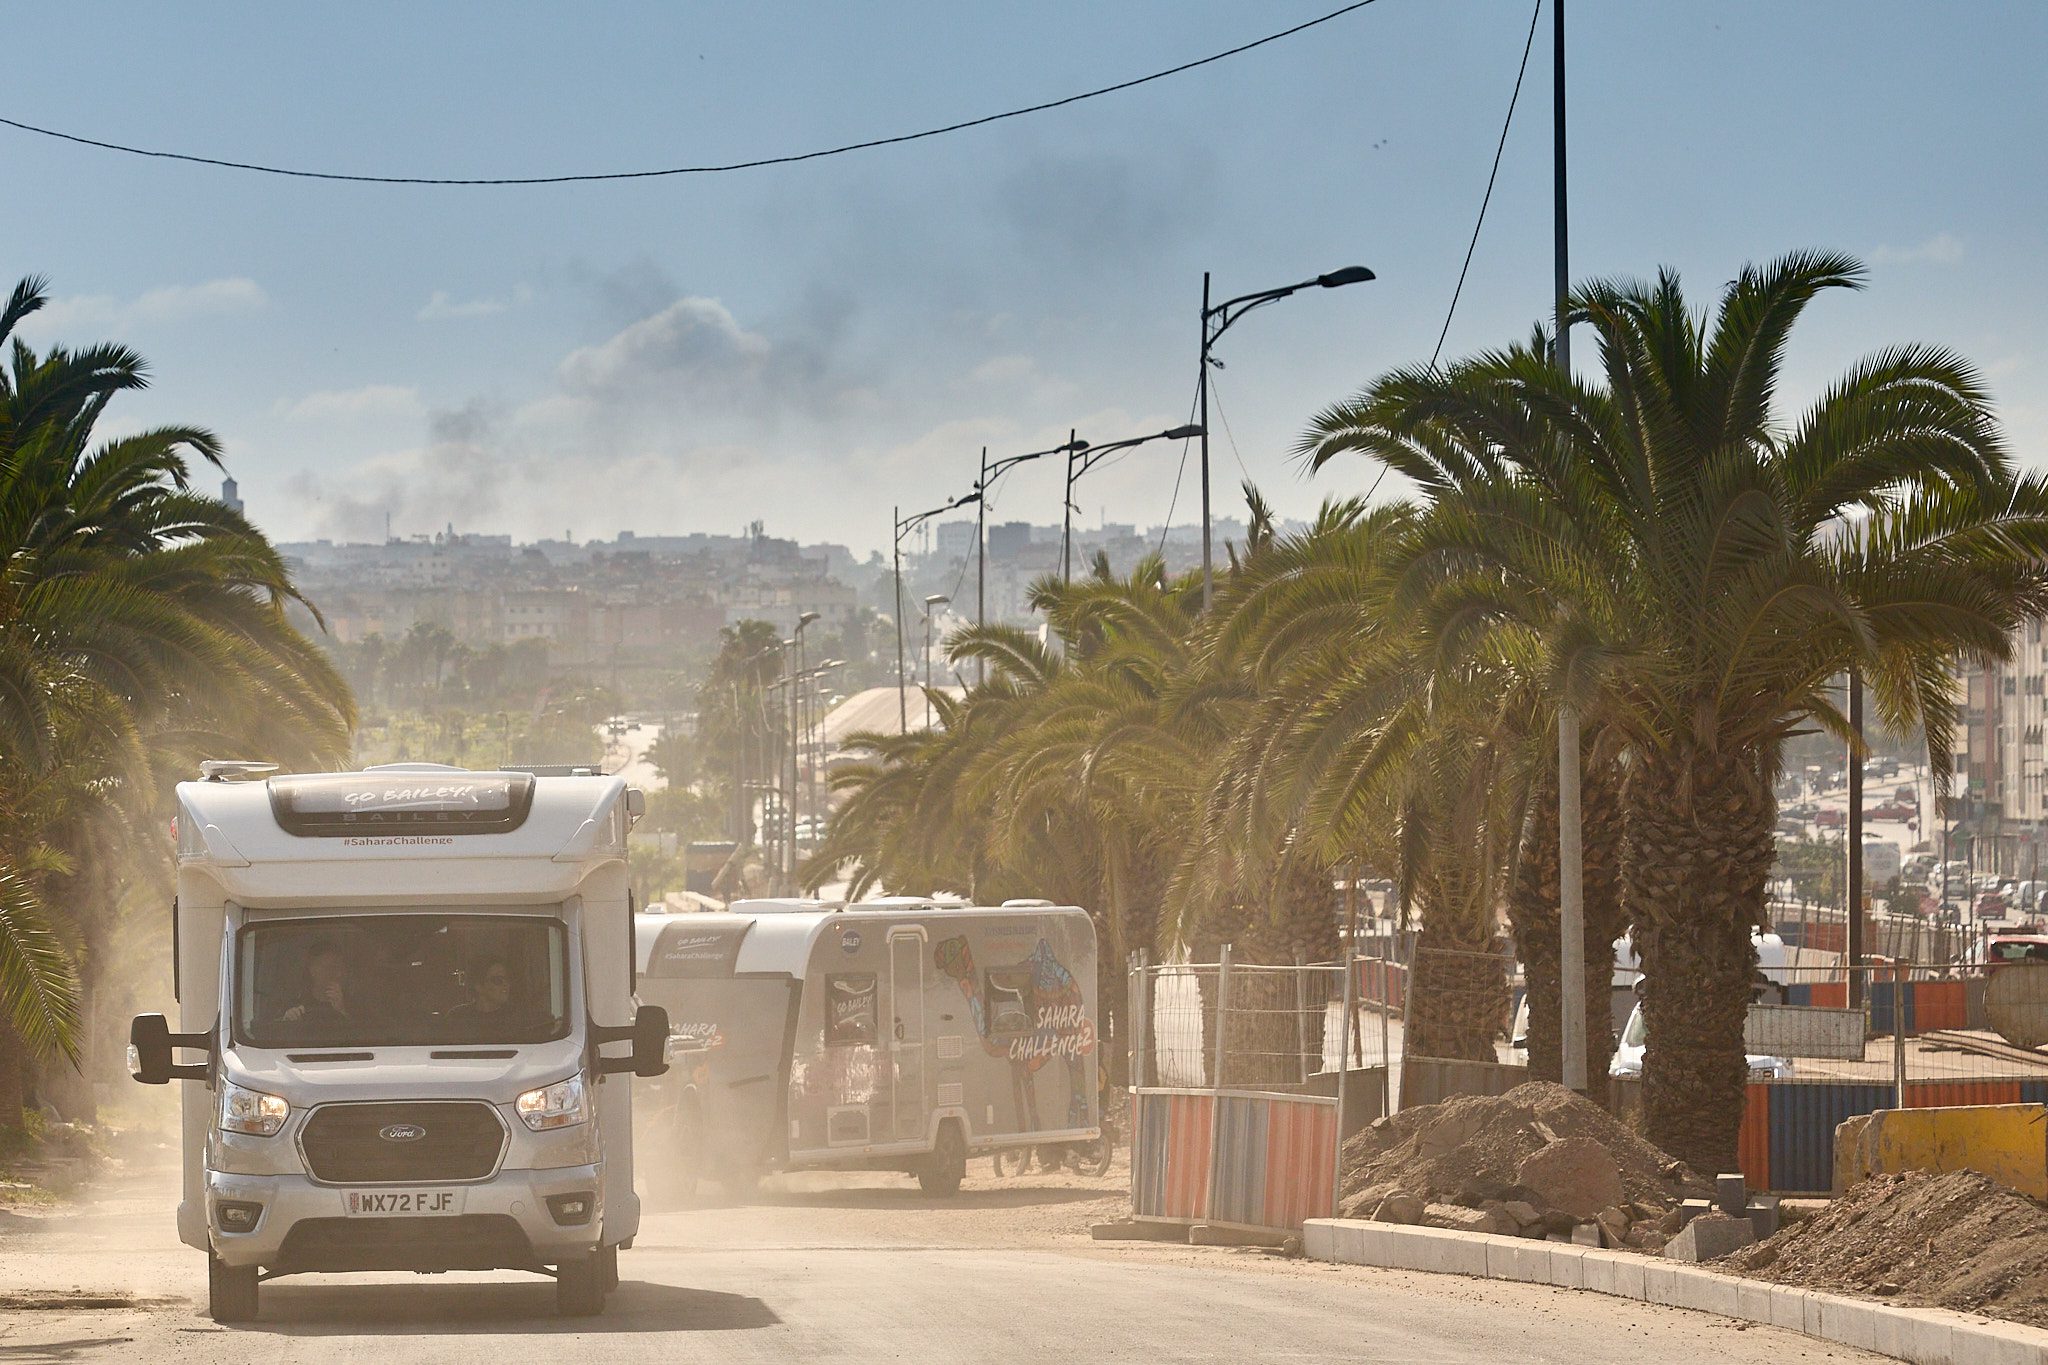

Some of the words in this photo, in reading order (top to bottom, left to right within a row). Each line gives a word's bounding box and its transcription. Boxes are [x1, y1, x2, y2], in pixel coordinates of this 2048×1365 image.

[345, 792, 376, 805] GO
[343, 812, 474, 821] BAILEY
[344, 837, 453, 846] #SaharaChallenge
[1036, 1004, 1085, 1029] SAHARA
[669, 1023, 717, 1036] AHARA
[389, 1126, 415, 1138] Ford
[362, 1194, 411, 1212] WX72
[416, 1193, 453, 1211] FJF
